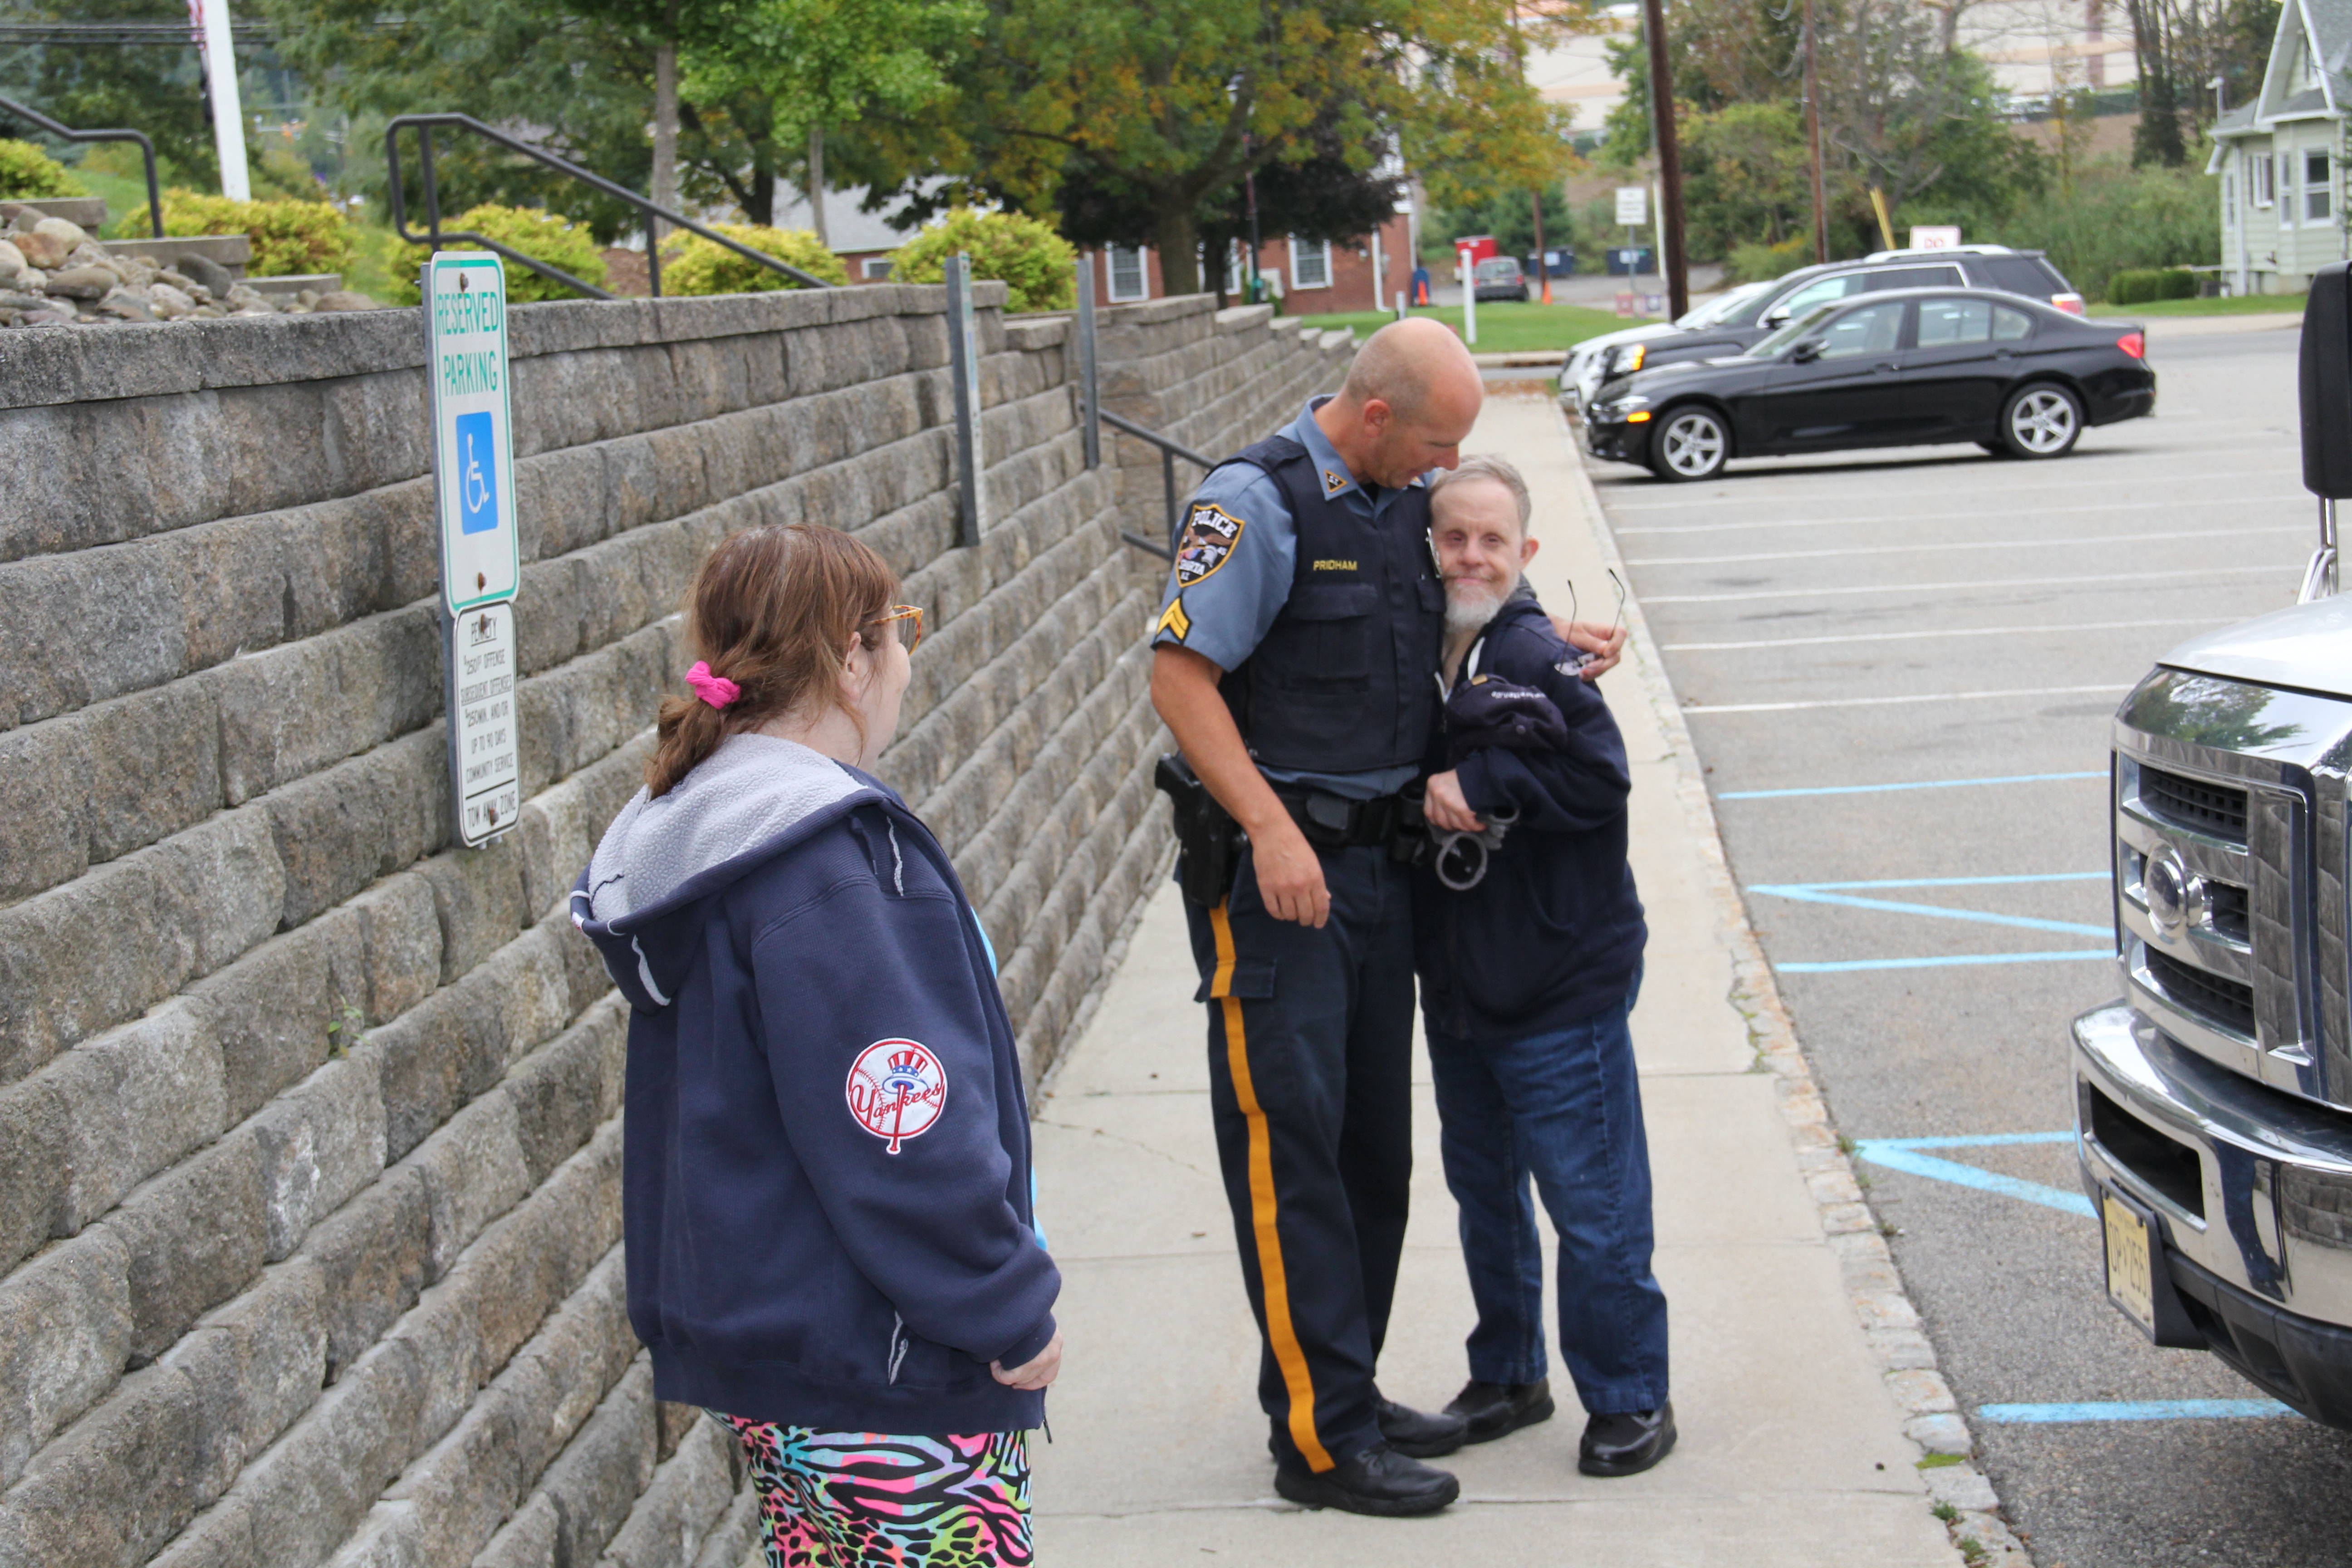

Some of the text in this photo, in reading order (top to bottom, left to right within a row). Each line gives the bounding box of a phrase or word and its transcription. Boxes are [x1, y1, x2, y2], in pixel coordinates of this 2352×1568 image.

[437, 292, 499, 336] RESERVED
[443, 351, 497, 396] PARKING
[1191, 510, 1238, 539] POLICE
[1313, 559, 1357, 572] PRIDHAM
[471, 617, 497, 644] PENLTY
[484, 649, 505, 669] OFFENSE
[490, 674, 513, 695] OFFENSES
[495, 728, 506, 746] DAYS
[466, 752, 514, 784] COMMUNITY SERVICE
[468, 804, 480, 828] TOW
[500, 790, 516, 815] ZONE
[850, 1083, 941, 1126] Yankees
